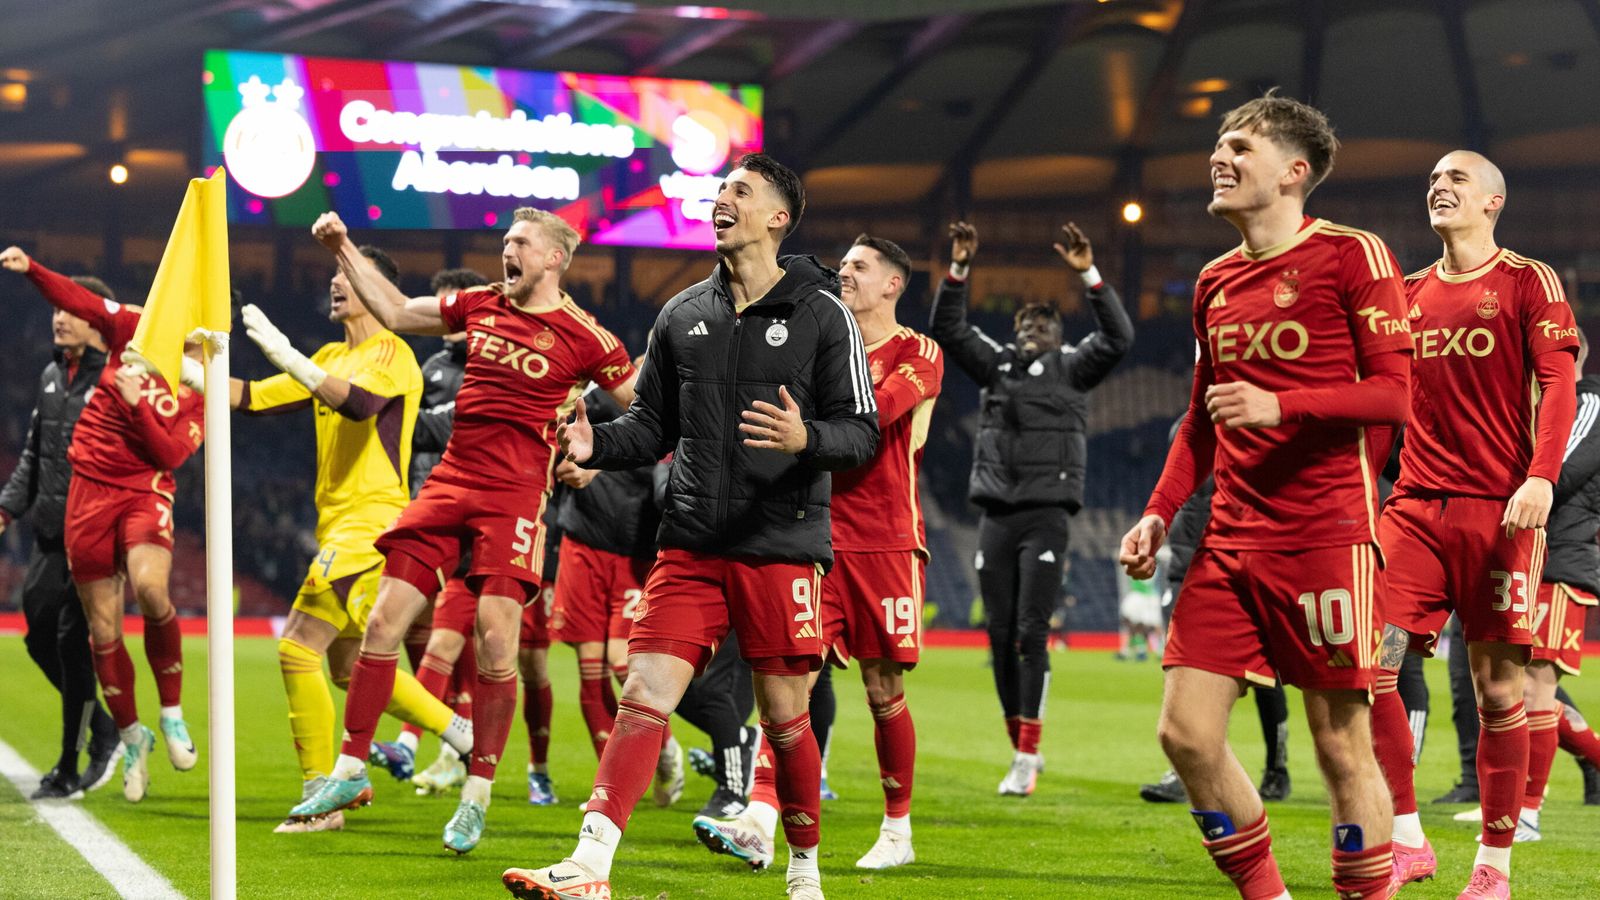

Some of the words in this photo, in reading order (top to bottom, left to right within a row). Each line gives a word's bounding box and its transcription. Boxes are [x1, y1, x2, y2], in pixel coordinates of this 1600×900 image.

[469, 330, 550, 379] TEXO
[155, 502, 170, 528] 7
[511, 516, 535, 554] 5
[792, 577, 815, 622] 9
[1489, 570, 1529, 613] 33
[881, 596, 916, 635] 19
[1298, 588, 1355, 647] 10
